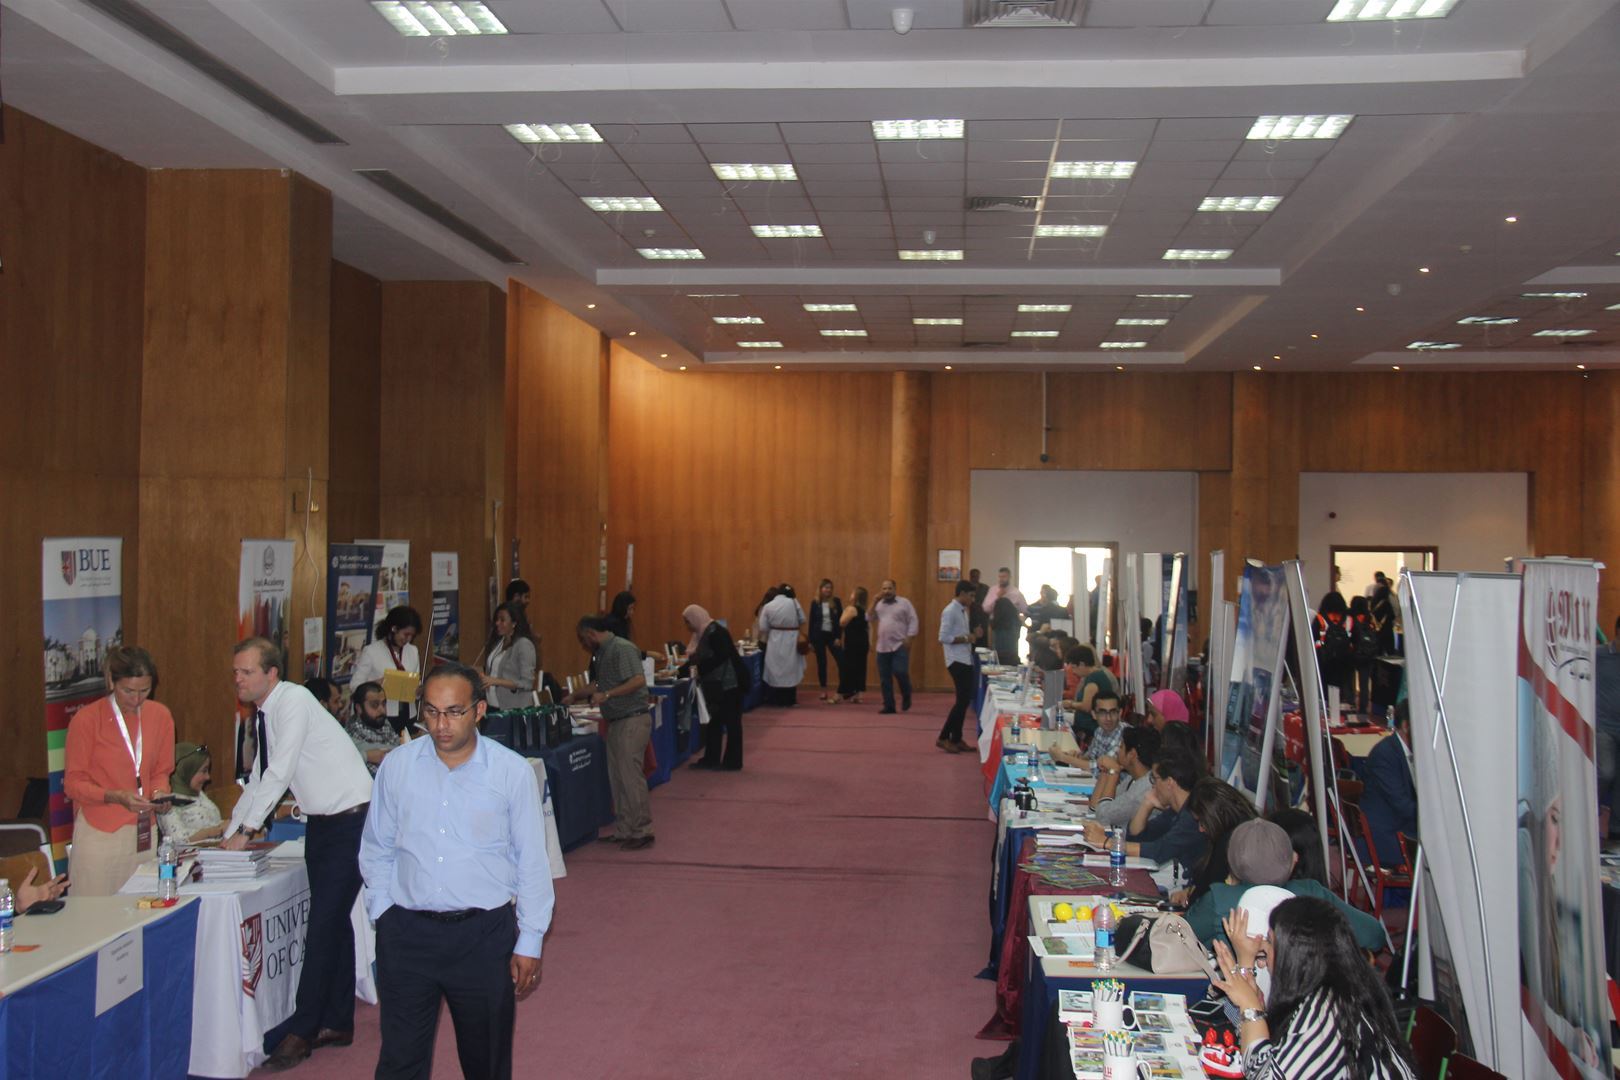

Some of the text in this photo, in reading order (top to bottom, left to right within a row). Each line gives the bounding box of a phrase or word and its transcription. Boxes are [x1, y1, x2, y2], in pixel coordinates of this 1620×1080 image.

[78, 548, 111, 572] BUE
[265, 898, 311, 944] UNIVE
[266, 946, 287, 980] OF
